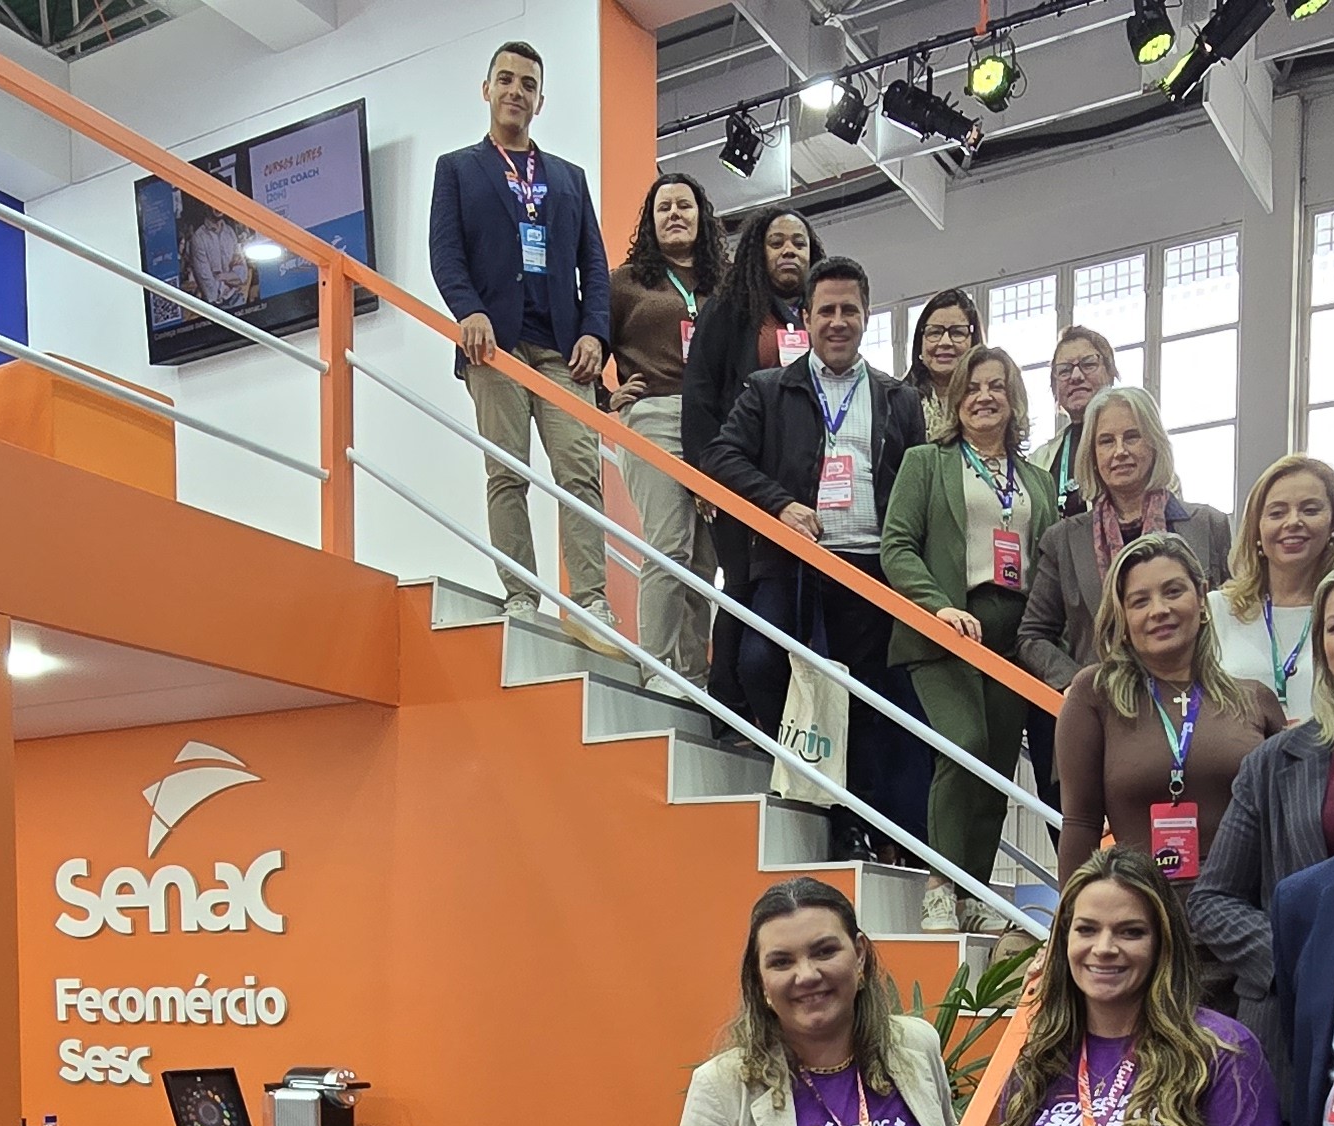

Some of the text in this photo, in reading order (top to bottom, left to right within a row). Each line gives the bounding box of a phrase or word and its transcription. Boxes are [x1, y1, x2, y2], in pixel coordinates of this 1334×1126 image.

[265, 167, 319, 193] LÍDER COACH
[1156, 856, 1179, 866] 1477
[55, 850, 284, 939] Senac
[55, 973, 287, 1026] Fecomércio
[59, 1039, 153, 1085] Sesc
